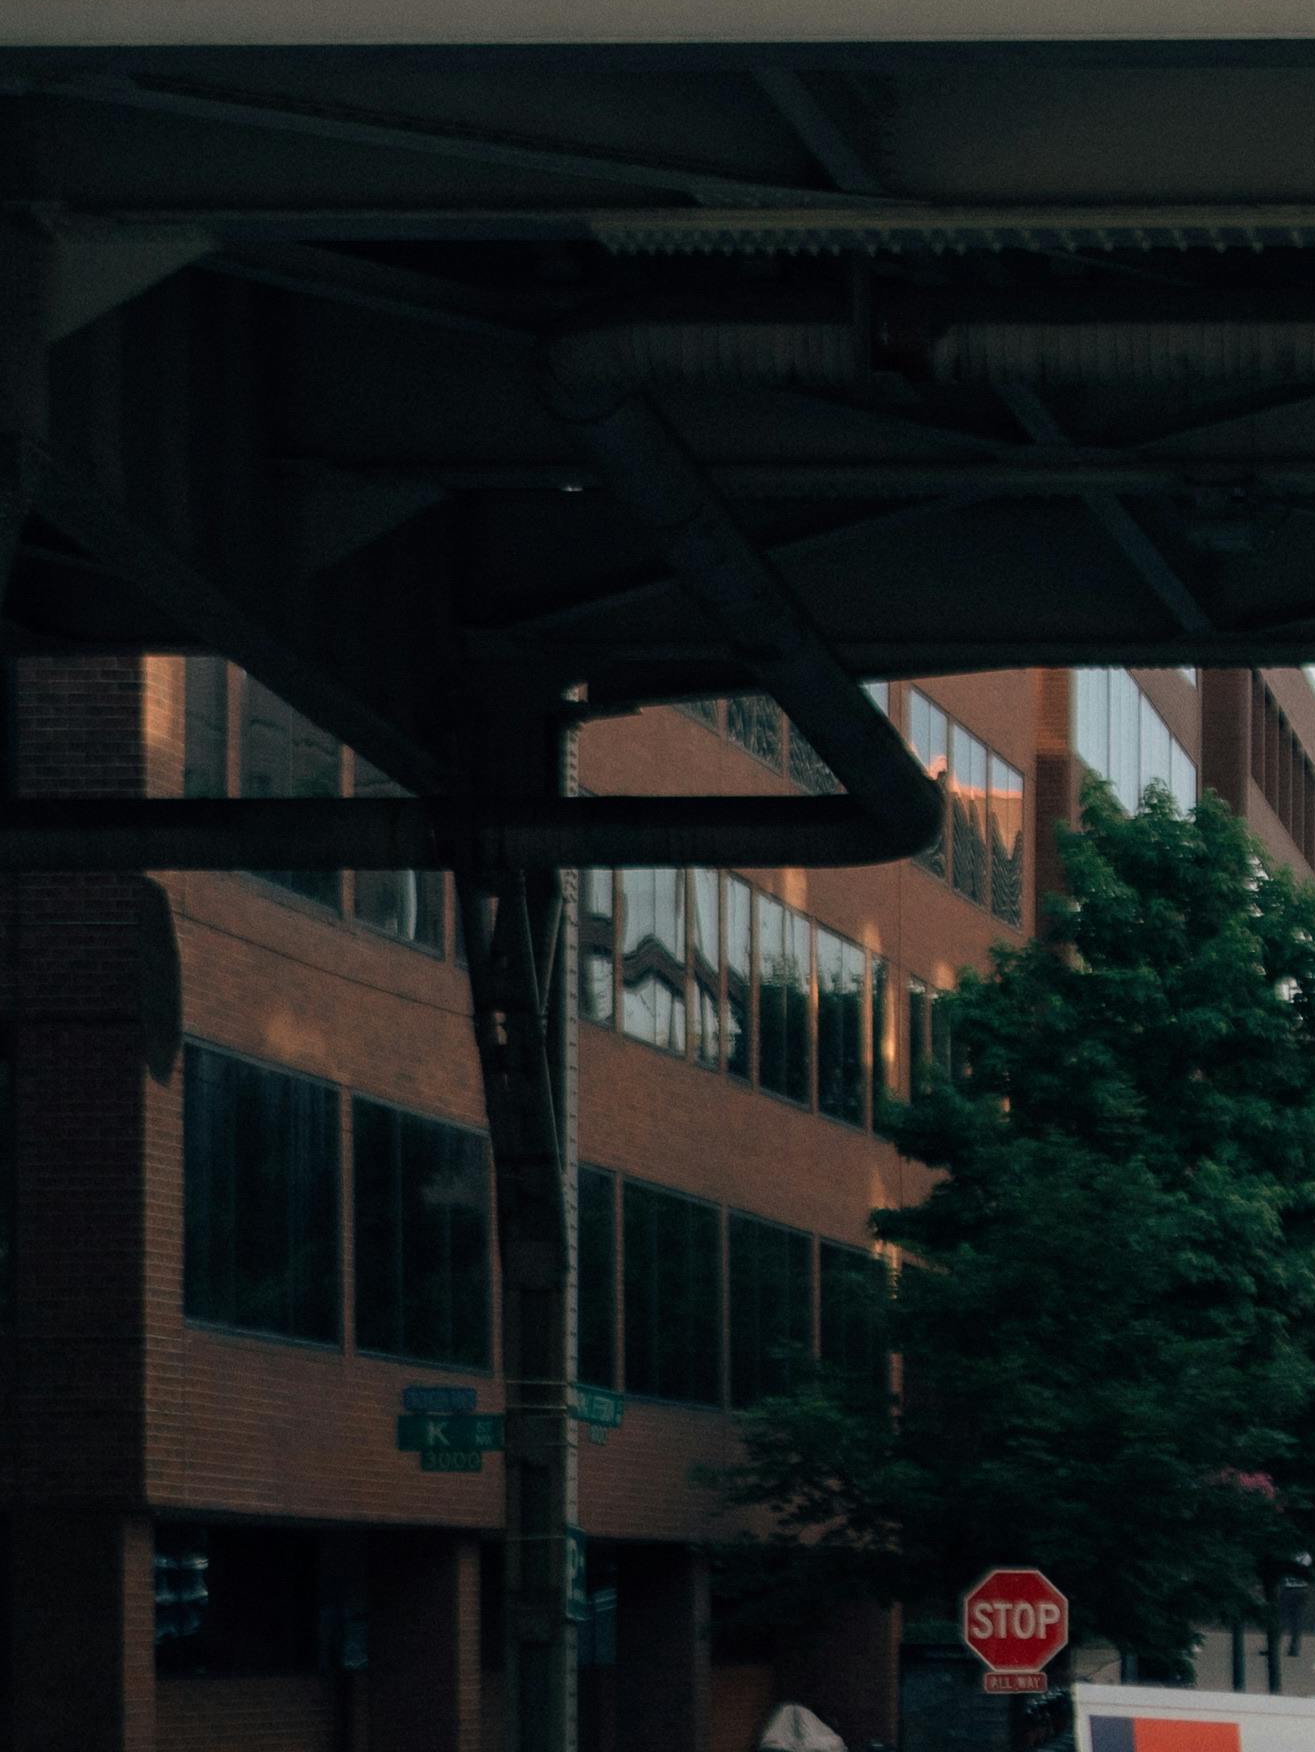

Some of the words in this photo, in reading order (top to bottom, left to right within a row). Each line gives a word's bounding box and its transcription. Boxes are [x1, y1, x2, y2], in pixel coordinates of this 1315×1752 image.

[426, 1420, 450, 1446] K
[426, 1450, 479, 1468] 3000
[972, 1602, 1060, 1639] STOP
[991, 1677, 1012, 1689] ALL
[1018, 1677, 1041, 1689] WAY
